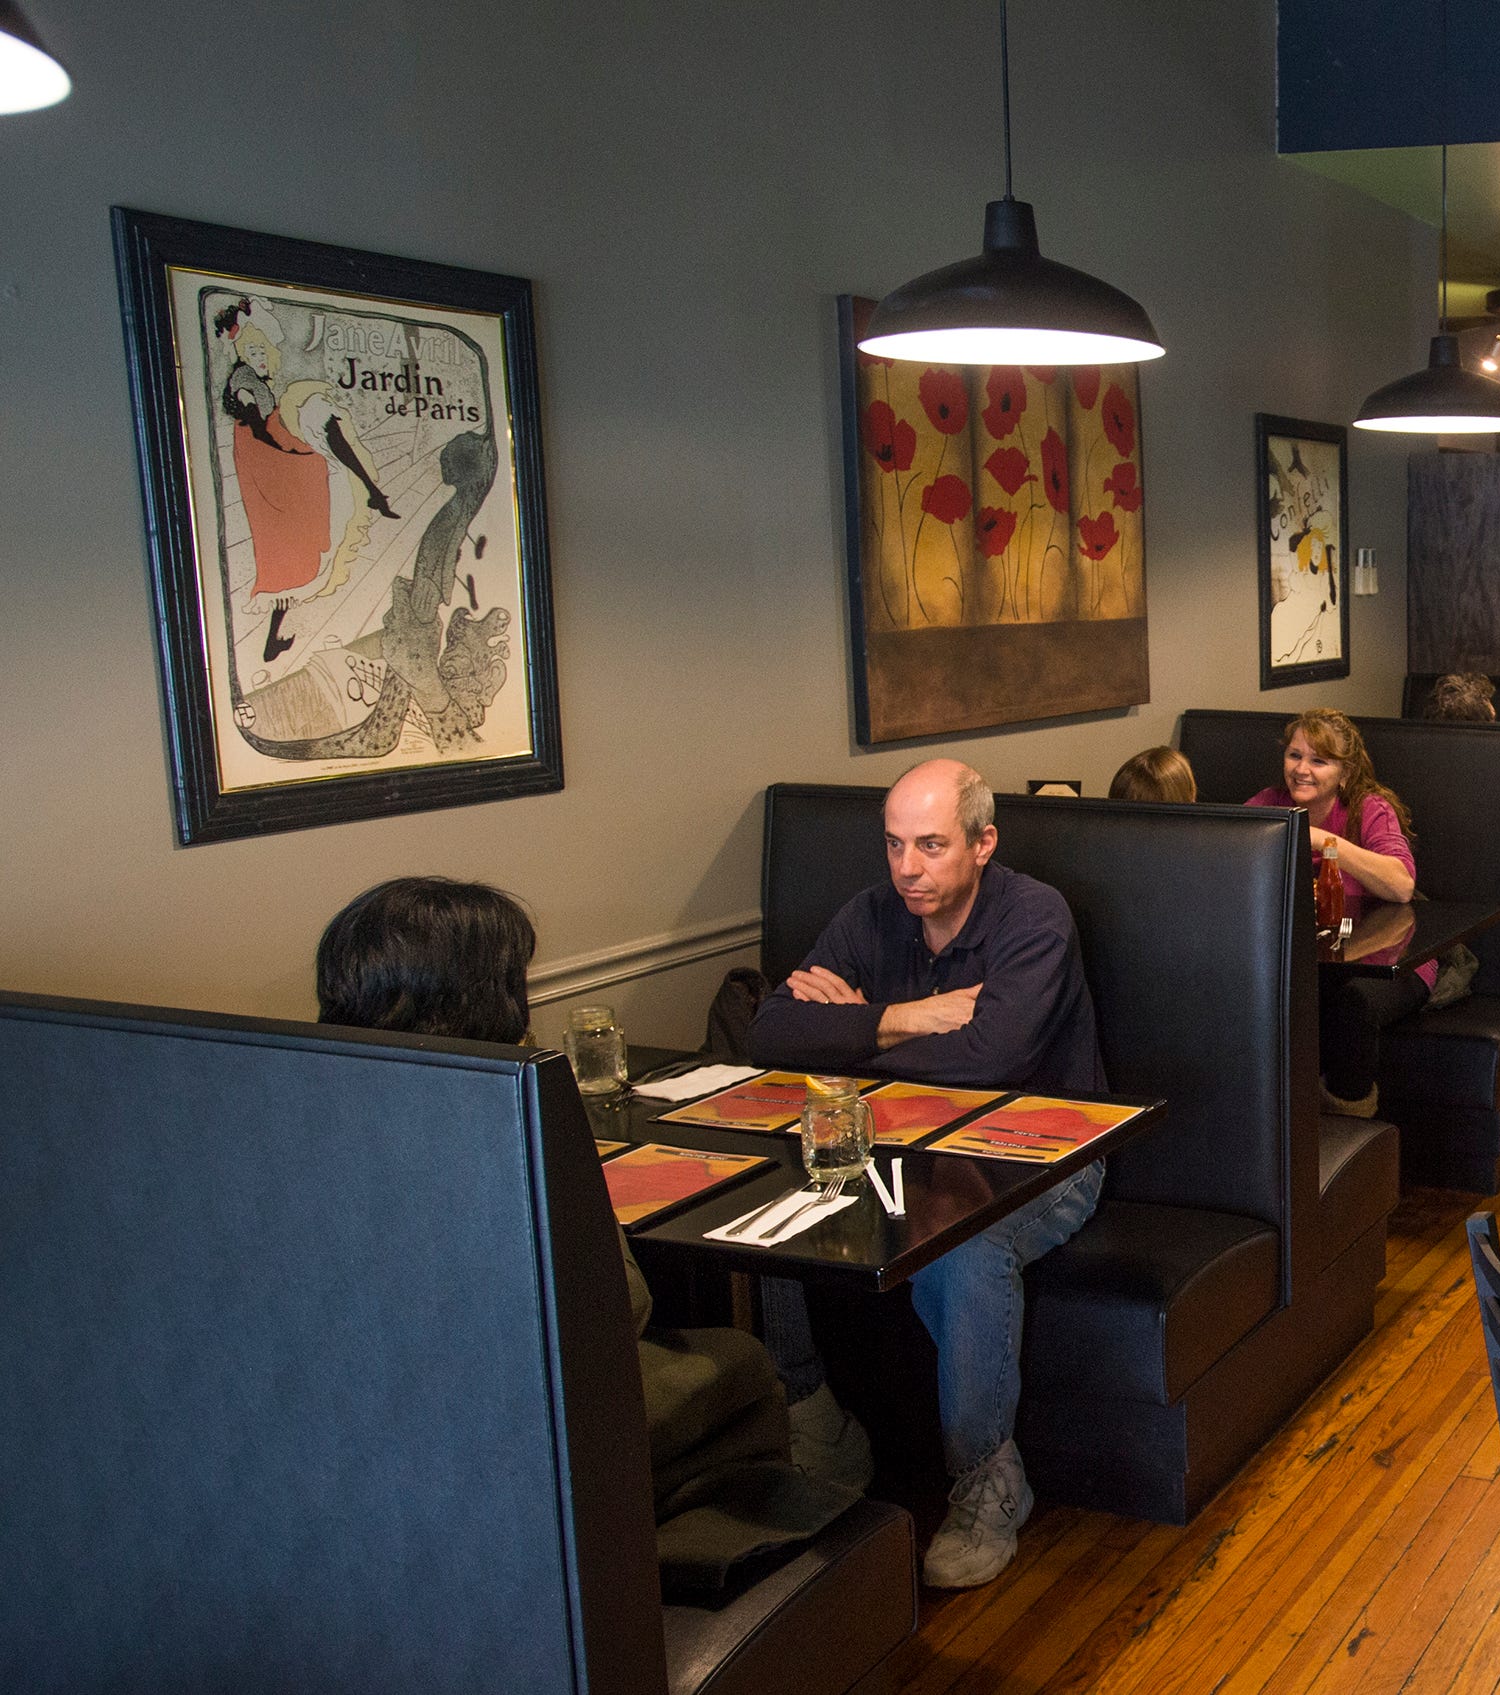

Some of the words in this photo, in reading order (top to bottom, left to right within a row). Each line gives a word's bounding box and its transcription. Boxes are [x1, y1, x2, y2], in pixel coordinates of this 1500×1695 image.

[303, 312, 385, 356] Jane
[385, 322, 464, 366] Avril
[337, 357, 443, 396] Jardin
[385, 396, 408, 417] de
[414, 397, 480, 423] Paris
